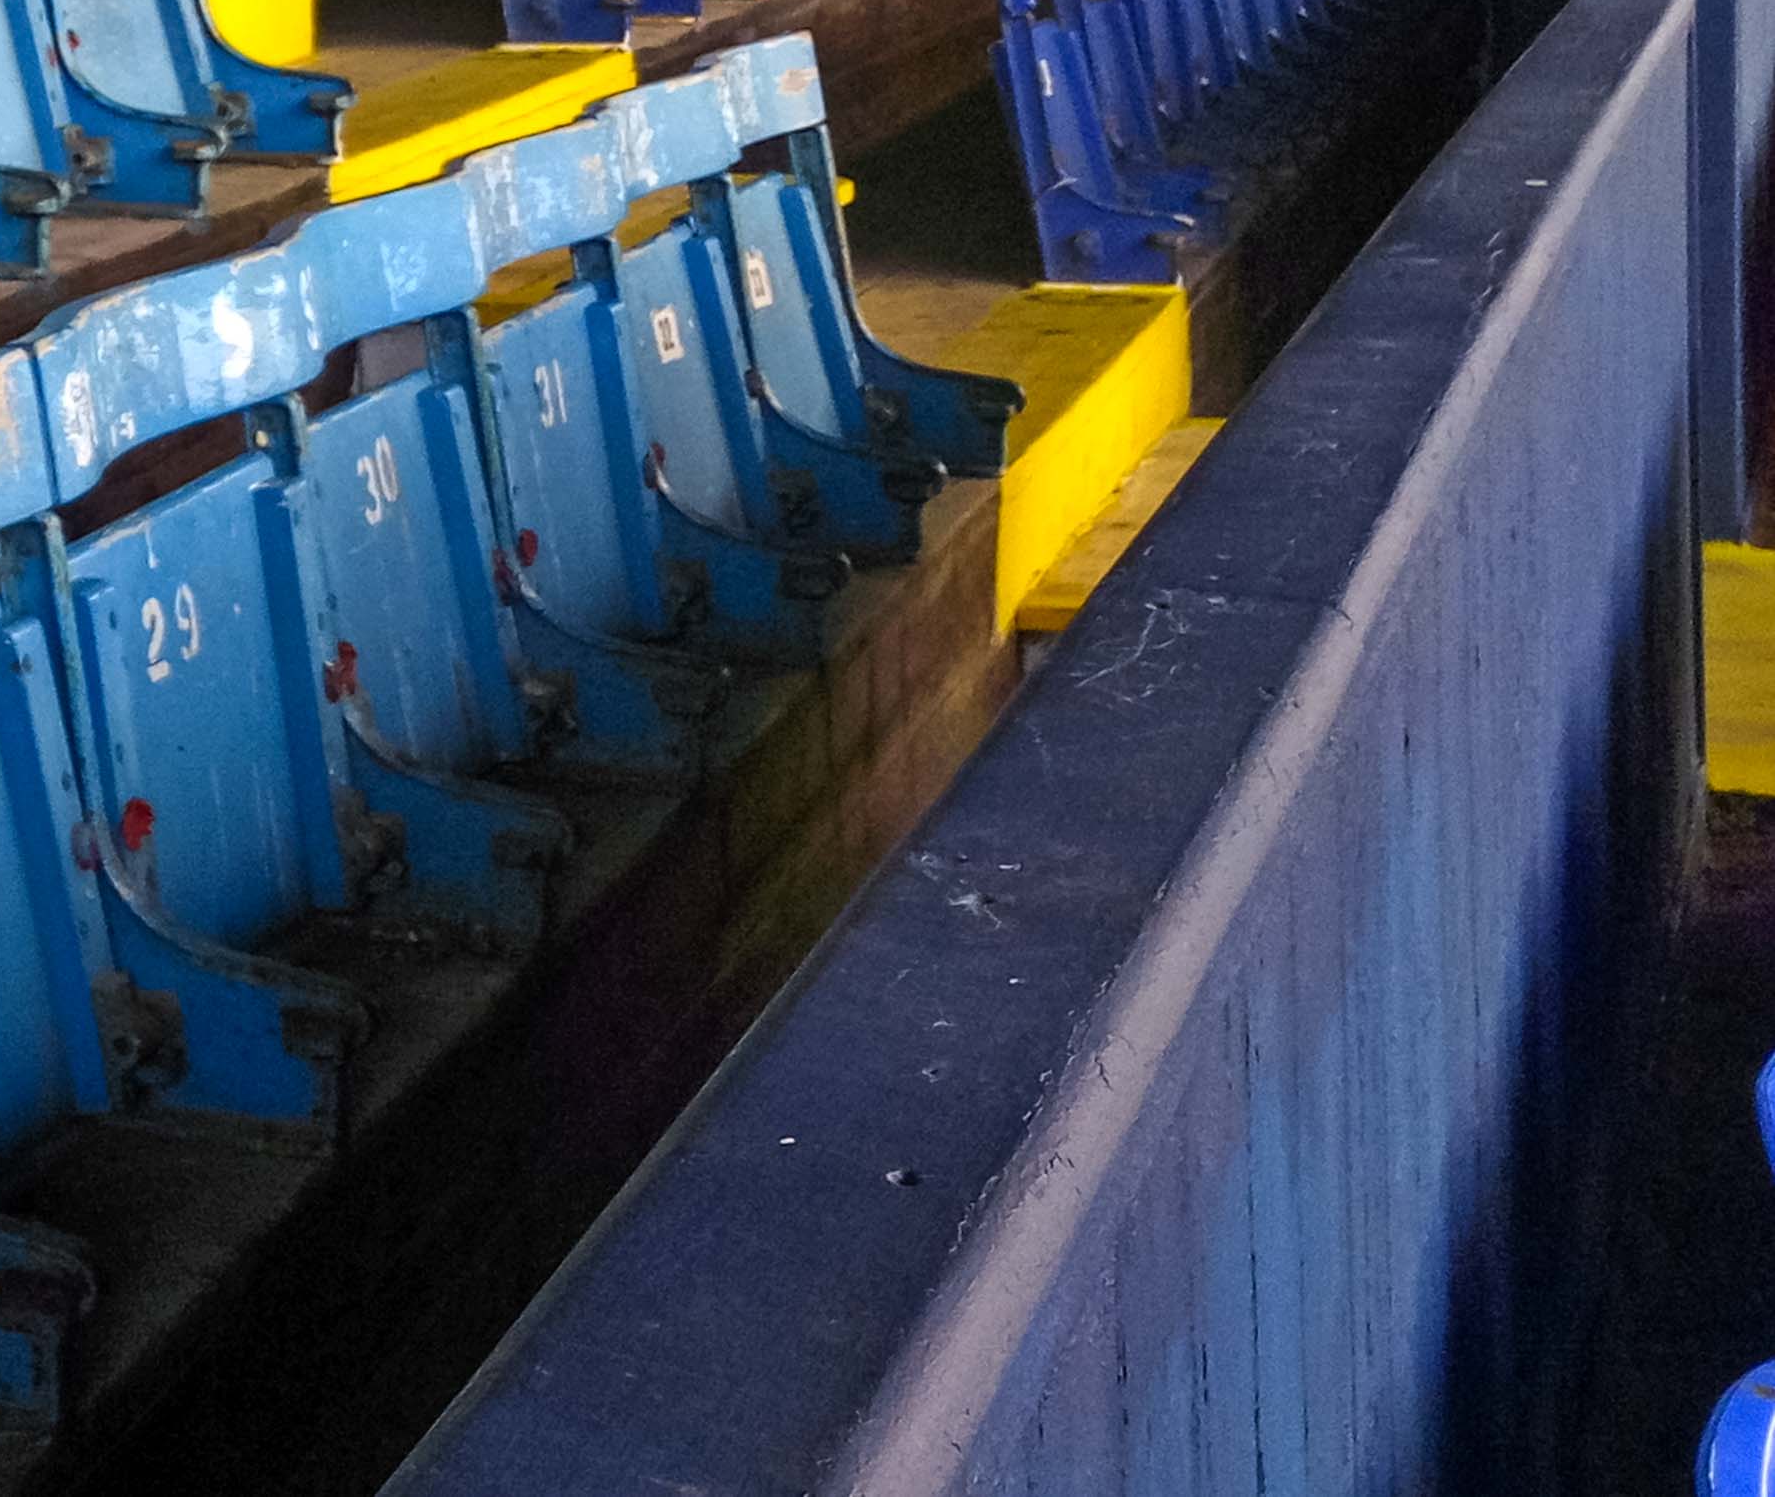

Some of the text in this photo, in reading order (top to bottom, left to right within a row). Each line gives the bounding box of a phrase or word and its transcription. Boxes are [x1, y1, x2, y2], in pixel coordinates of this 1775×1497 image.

[535, 359, 567, 427] 31
[357, 435, 398, 525] 30
[142, 584, 199, 682] 29
